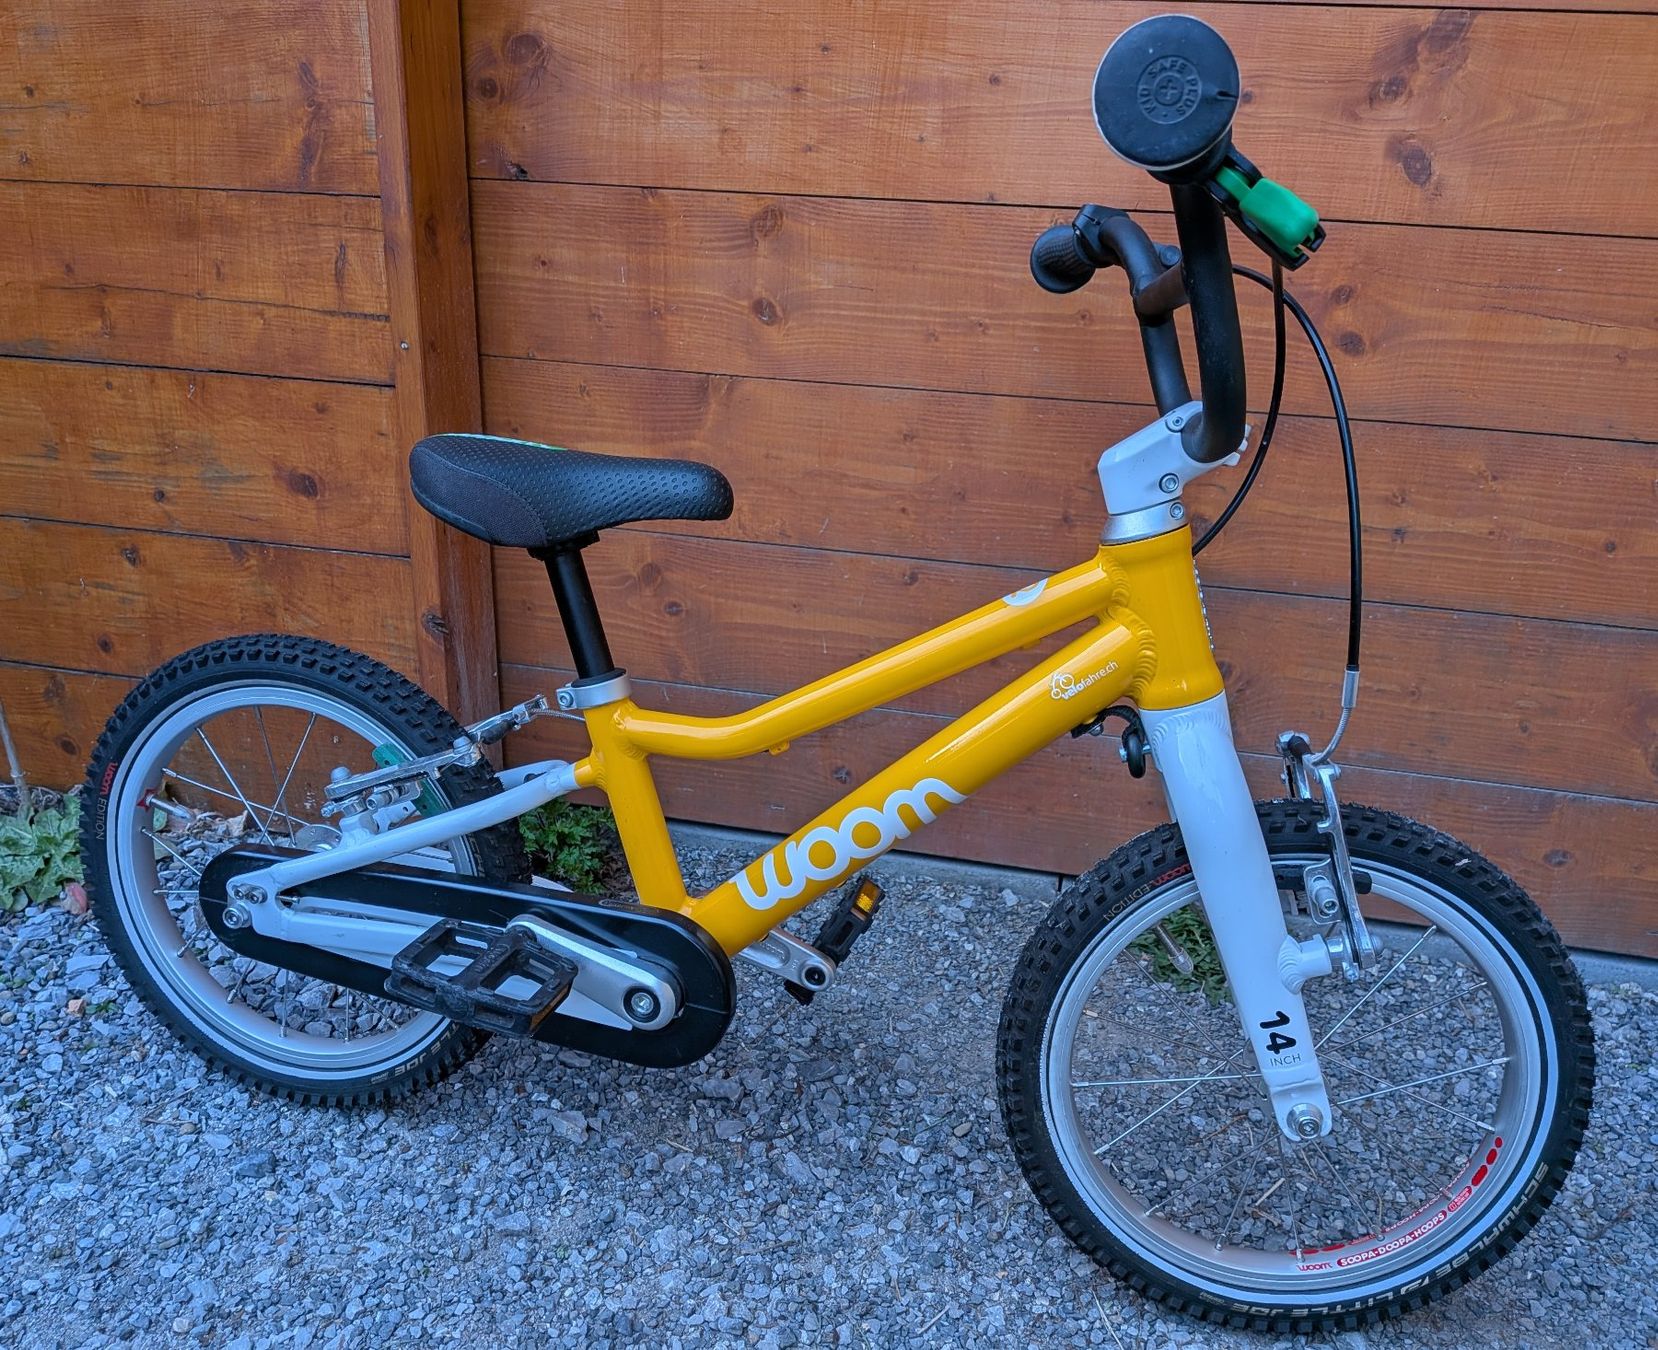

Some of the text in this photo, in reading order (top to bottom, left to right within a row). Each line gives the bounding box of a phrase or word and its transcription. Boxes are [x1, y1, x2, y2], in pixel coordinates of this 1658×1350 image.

[1147, 59, 1188, 79] SAFE
[1176, 77, 1198, 116] PLUS
[95, 761, 118, 840] woom EDITION
[728, 777, 968, 911] woom
[1103, 883, 1151, 921] EDITION
[1259, 1010, 1297, 1055] 14
[394, 1052, 427, 1077] JOE
[1270, 1053, 1302, 1067] INCH
[1297, 1262, 1332, 1272] woom
[1341, 1211, 1445, 1267] SOOPA-DOOPA-HOOPS
[1435, 1161, 1549, 1279] SCHWALBE
[1231, 1302, 1284, 1317] JOE
[1290, 1291, 1394, 1318] LITTLE
